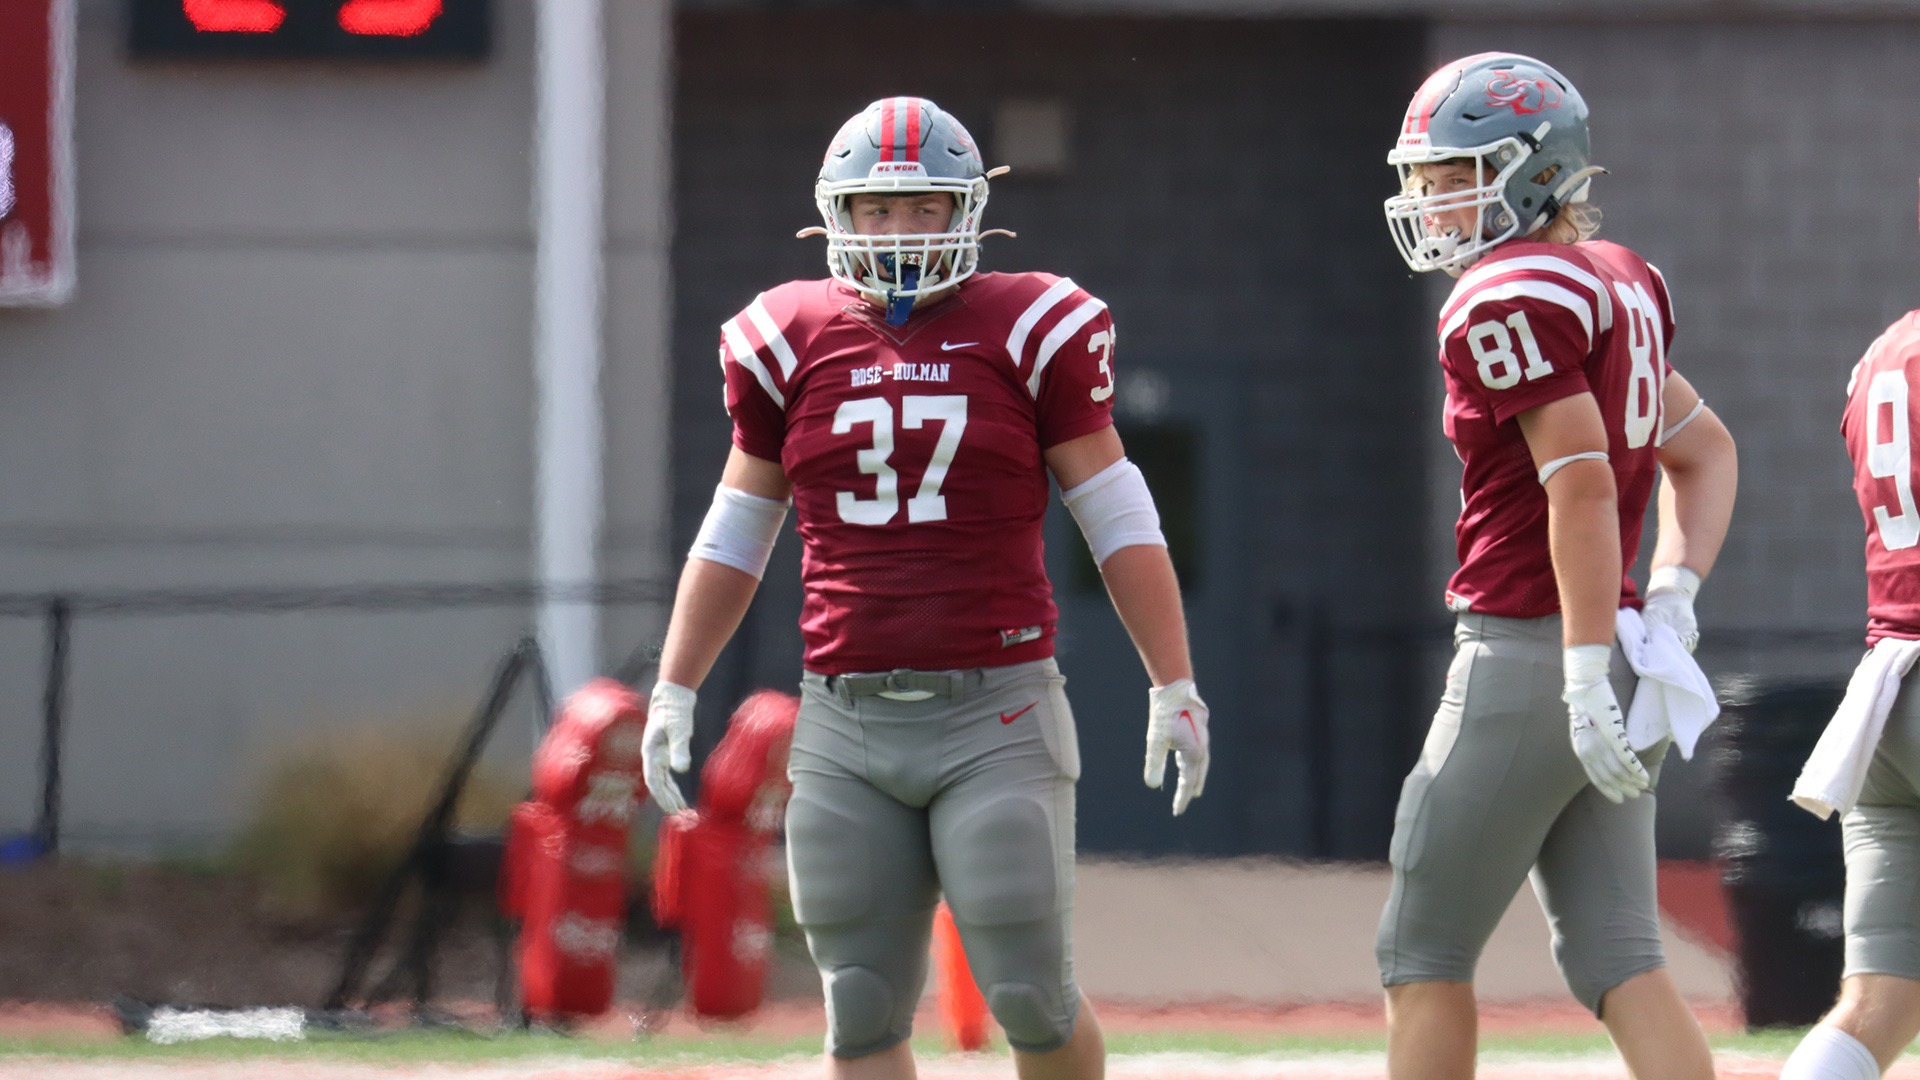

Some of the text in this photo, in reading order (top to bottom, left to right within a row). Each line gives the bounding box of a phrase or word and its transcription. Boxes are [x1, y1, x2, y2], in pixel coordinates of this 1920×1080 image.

[850, 363, 950, 387] ROSE-HULMAN
[1466, 310, 1554, 390] 81
[1612, 280, 1666, 449] 81
[831, 395, 968, 525] 37
